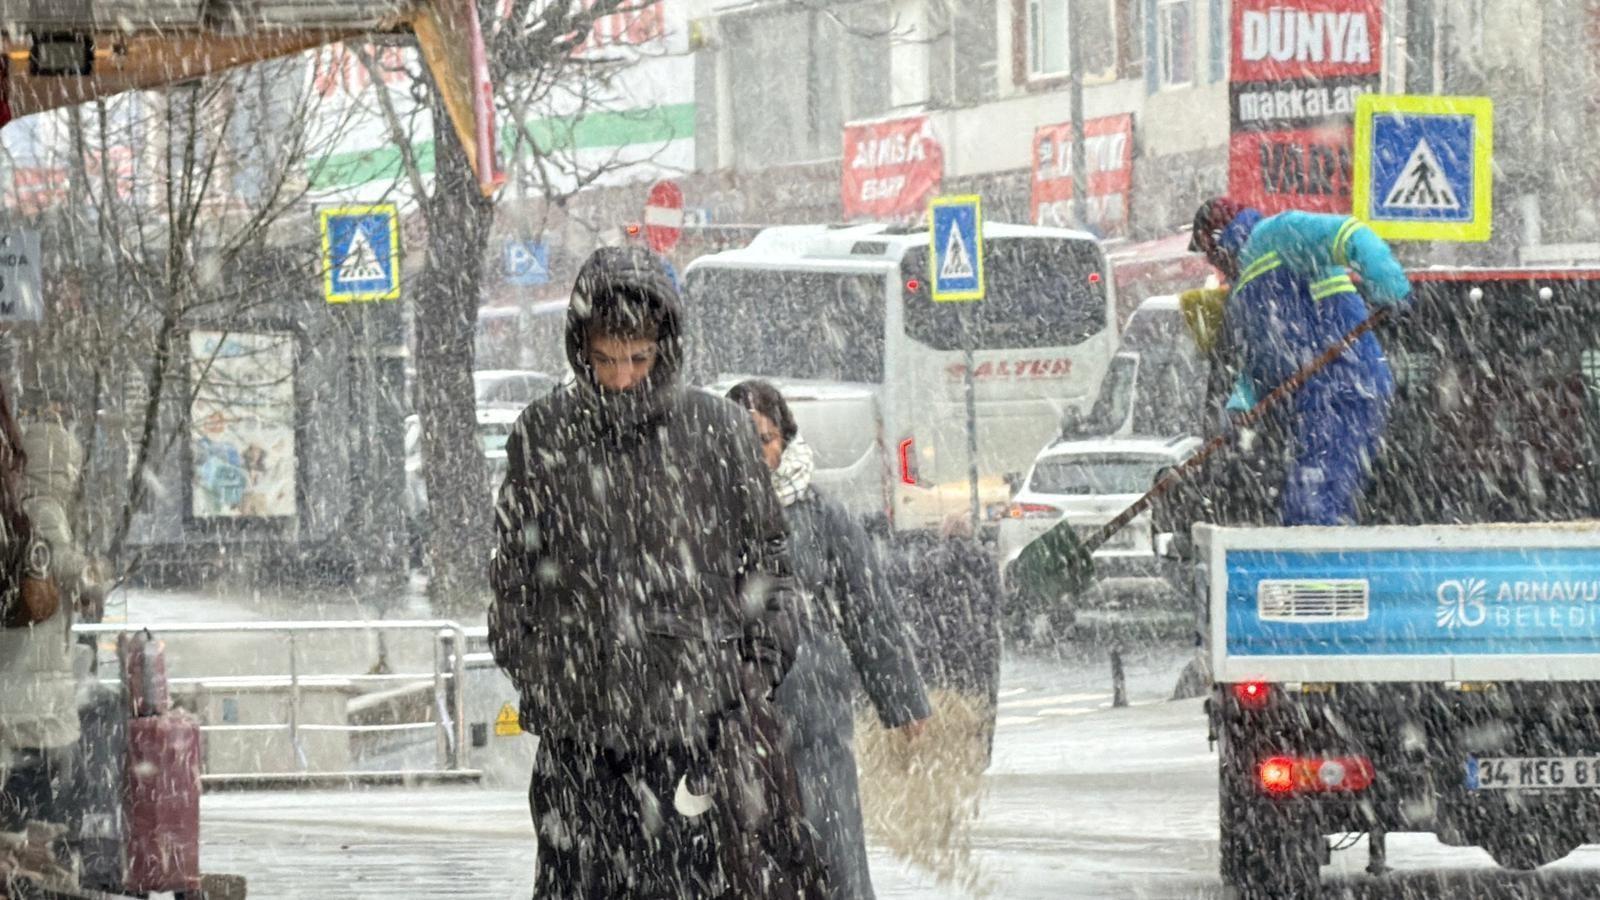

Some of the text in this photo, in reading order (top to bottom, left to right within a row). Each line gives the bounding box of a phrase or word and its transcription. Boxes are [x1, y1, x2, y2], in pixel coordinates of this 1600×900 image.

[1242, 6, 1371, 63] DÜNYA
[1497, 581, 1600, 602] ARNAVU
[1481, 760, 1509, 785] 34
